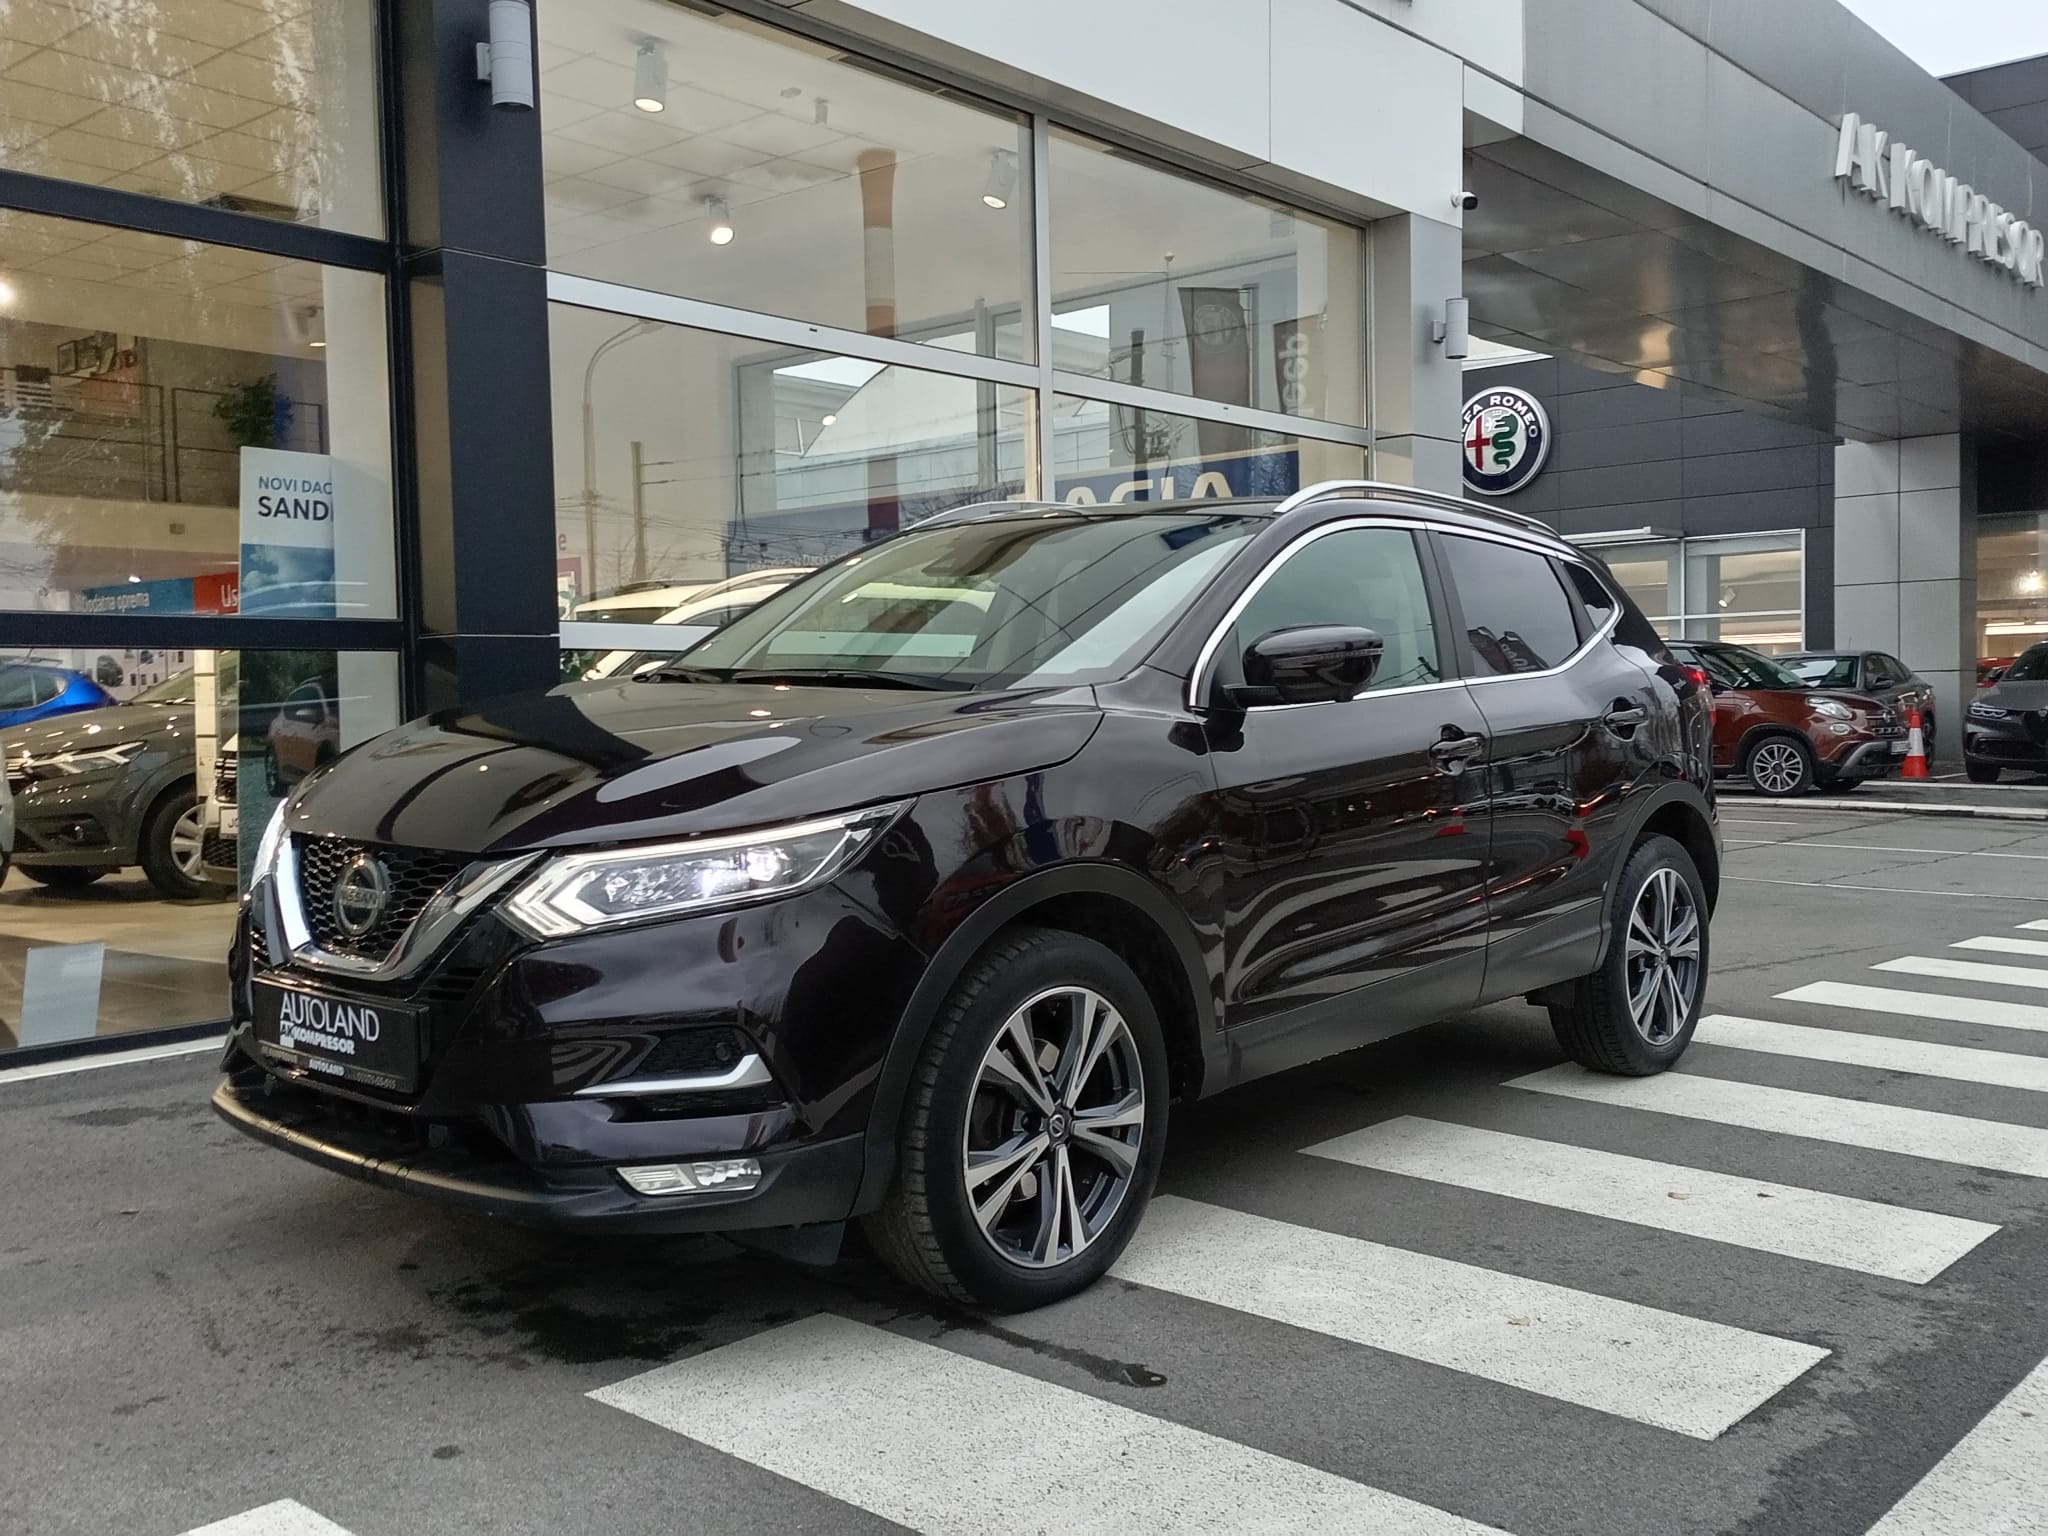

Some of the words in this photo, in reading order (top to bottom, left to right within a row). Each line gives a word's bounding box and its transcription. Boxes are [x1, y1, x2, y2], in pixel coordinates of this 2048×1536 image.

[1490, 395, 1538, 438] ROMEO
[259, 476, 297, 492] NOVI
[258, 495, 334, 521] SAND
[280, 990, 380, 1042] AUTOLAND
